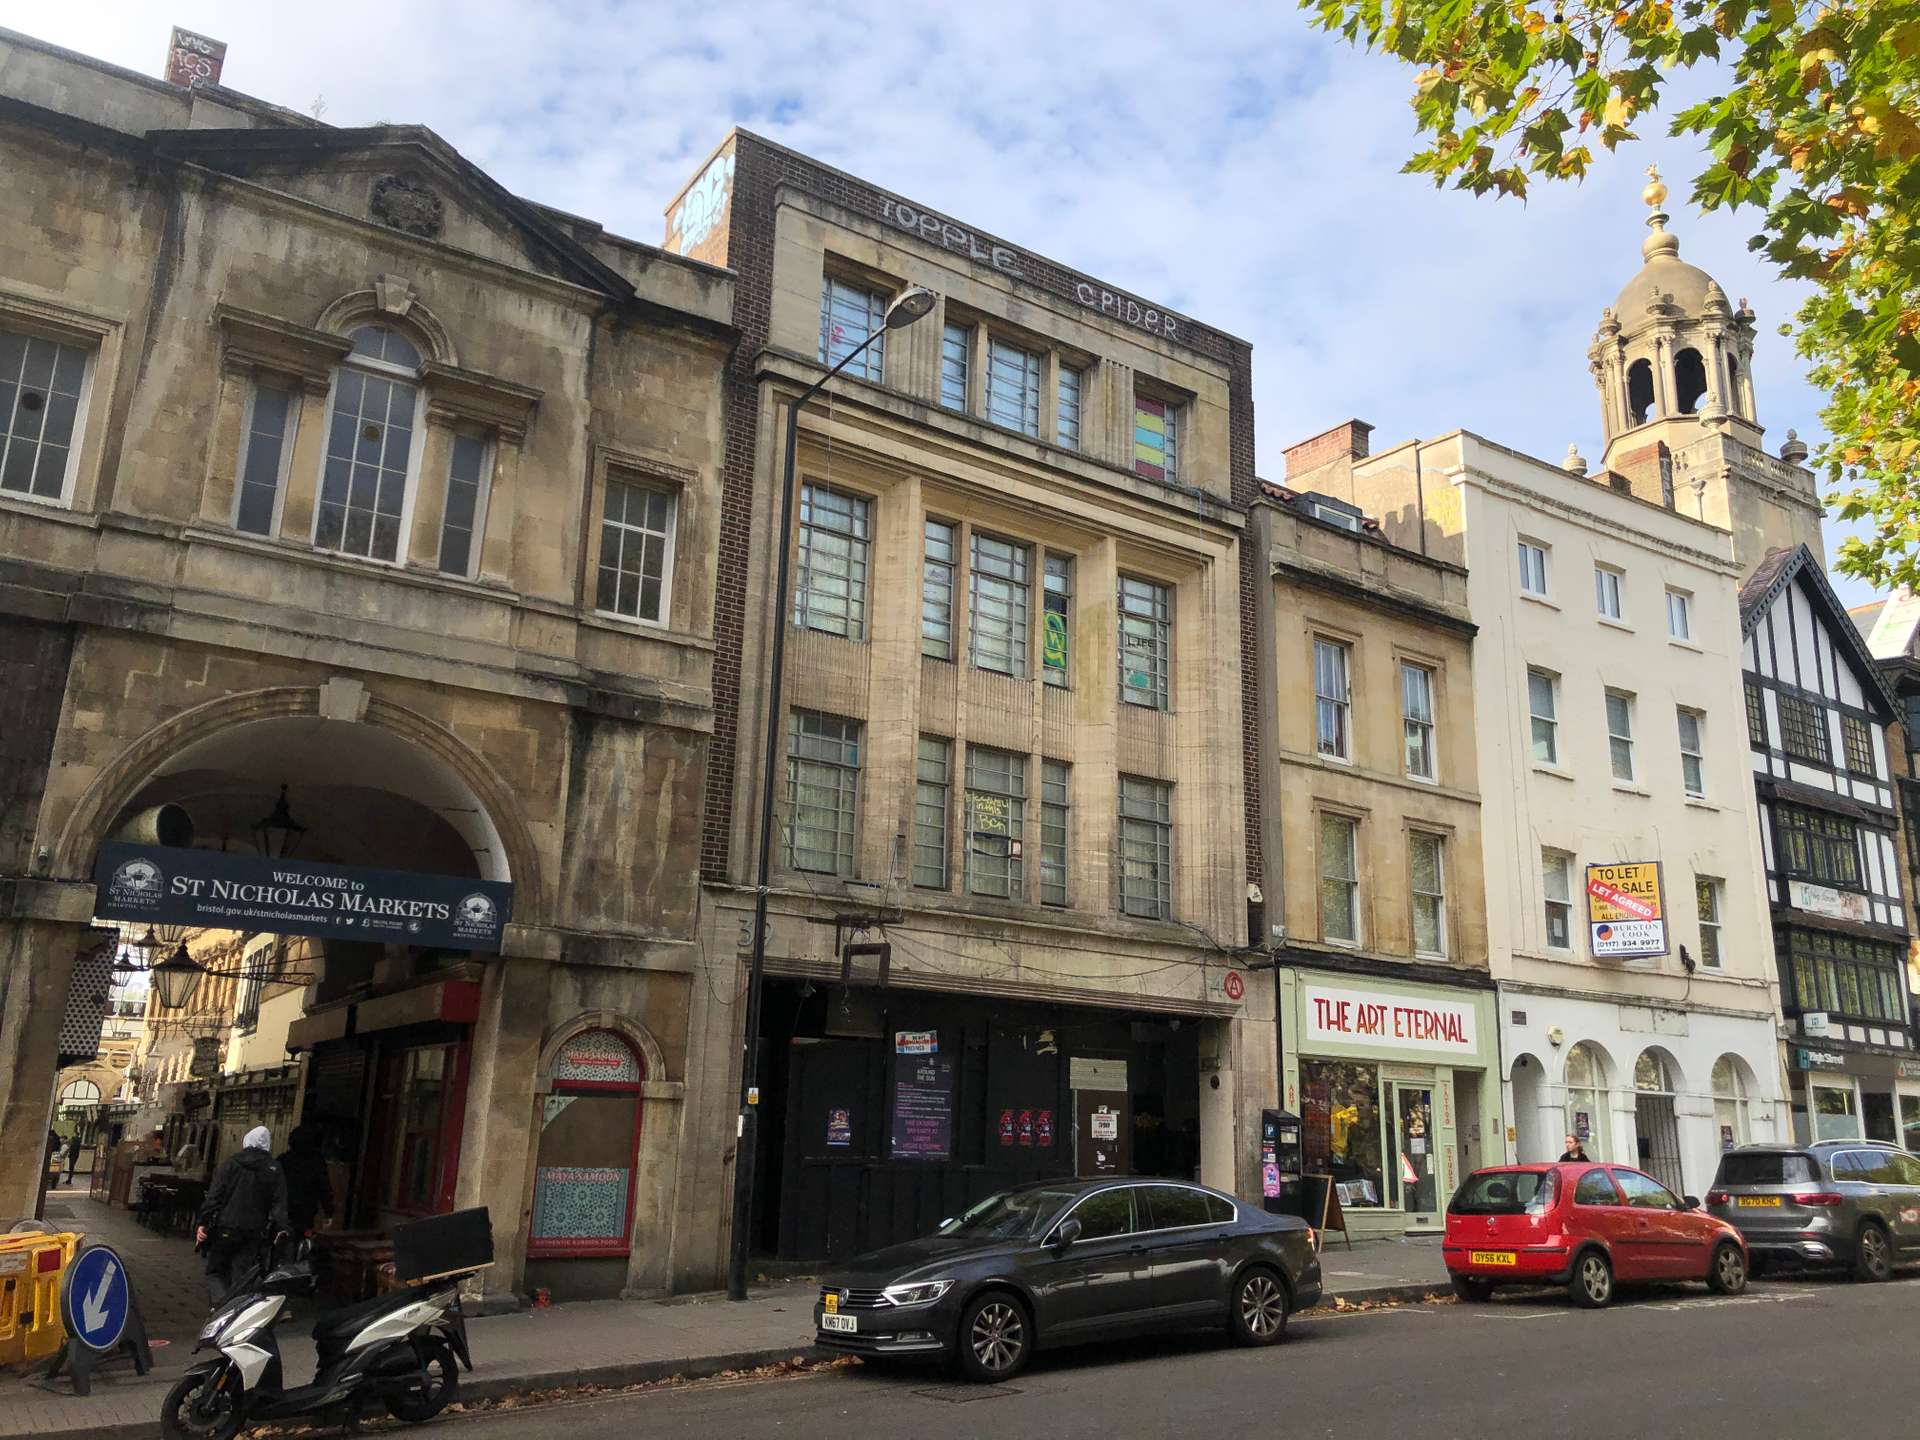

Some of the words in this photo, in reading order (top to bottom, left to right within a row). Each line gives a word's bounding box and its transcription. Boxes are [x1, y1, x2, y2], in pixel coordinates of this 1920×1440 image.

[880, 196, 1023, 278] TOPPLE
[272, 871, 348, 890] WELCOME
[350, 881, 365, 892] to
[1598, 868, 1614, 881] TO
[1617, 867, 1640, 879] LET
[122, 888, 162, 899] NICHOLAS
[1622, 881, 1654, 893] SALE
[113, 895, 157, 905] MARKETS
[170, 875, 205, 897] ST
[210, 879, 335, 909] NICHOLAS
[339, 892, 450, 920] MARKETS
[1592, 883, 1611, 897] LET
[1612, 892, 1652, 917] AGREED
[197, 904, 328, 924] bristol.gov.uk/stnicholasmarkets
[1622, 939, 1637, 947] 934
[1313, 998, 1352, 1033] THE
[1356, 1003, 1388, 1036] ART
[1393, 1007, 1469, 1043] ETERNAL
[1496, 1254, 1512, 1264] KXL
